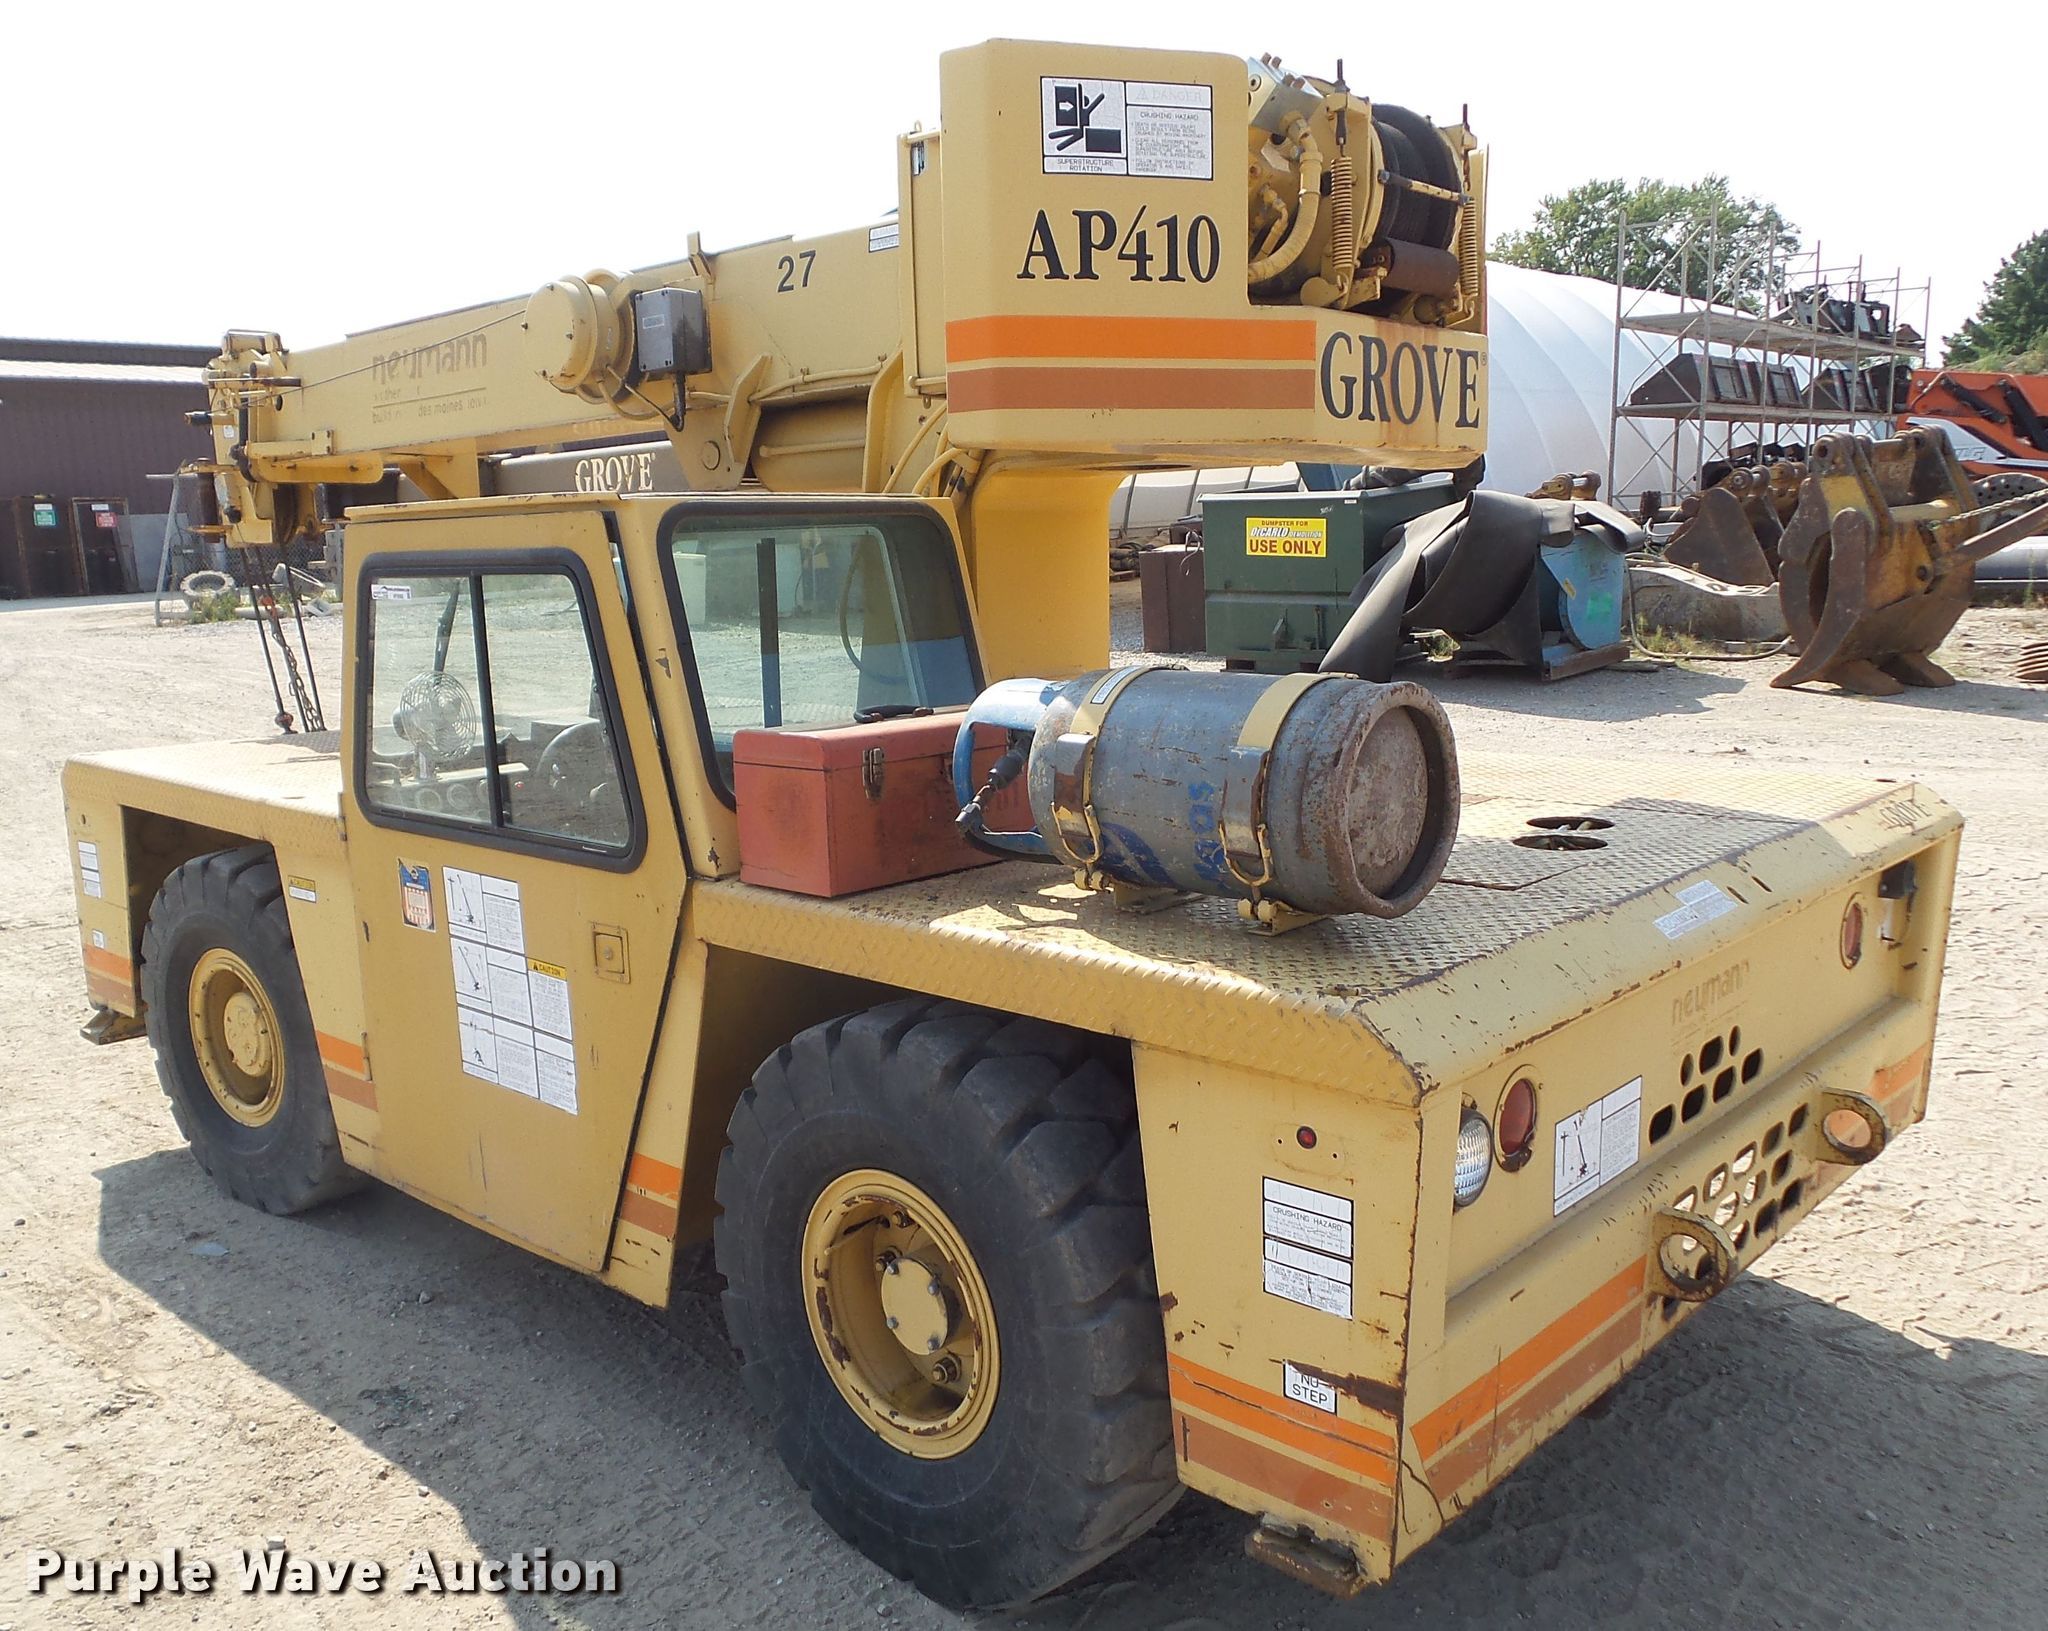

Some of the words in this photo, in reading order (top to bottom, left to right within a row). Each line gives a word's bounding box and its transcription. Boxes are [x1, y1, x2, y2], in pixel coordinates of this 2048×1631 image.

[1057, 158, 1114, 167] SUPERSTRUCTURE
[1069, 165, 1103, 173] ROTATION
[1017, 205, 1221, 283] AP410
[777, 250, 817, 293] 27
[1320, 332, 1480, 428] GROVE
[575, 453, 653, 492] GROVE
[1249, 539, 1278, 554] USE
[1282, 540, 1322, 555] ONLY
[1272, 1206, 1310, 1222] CRUSHING
[1313, 1217, 1343, 1232] HAZARD
[1292, 1383, 1328, 1404] STEP
